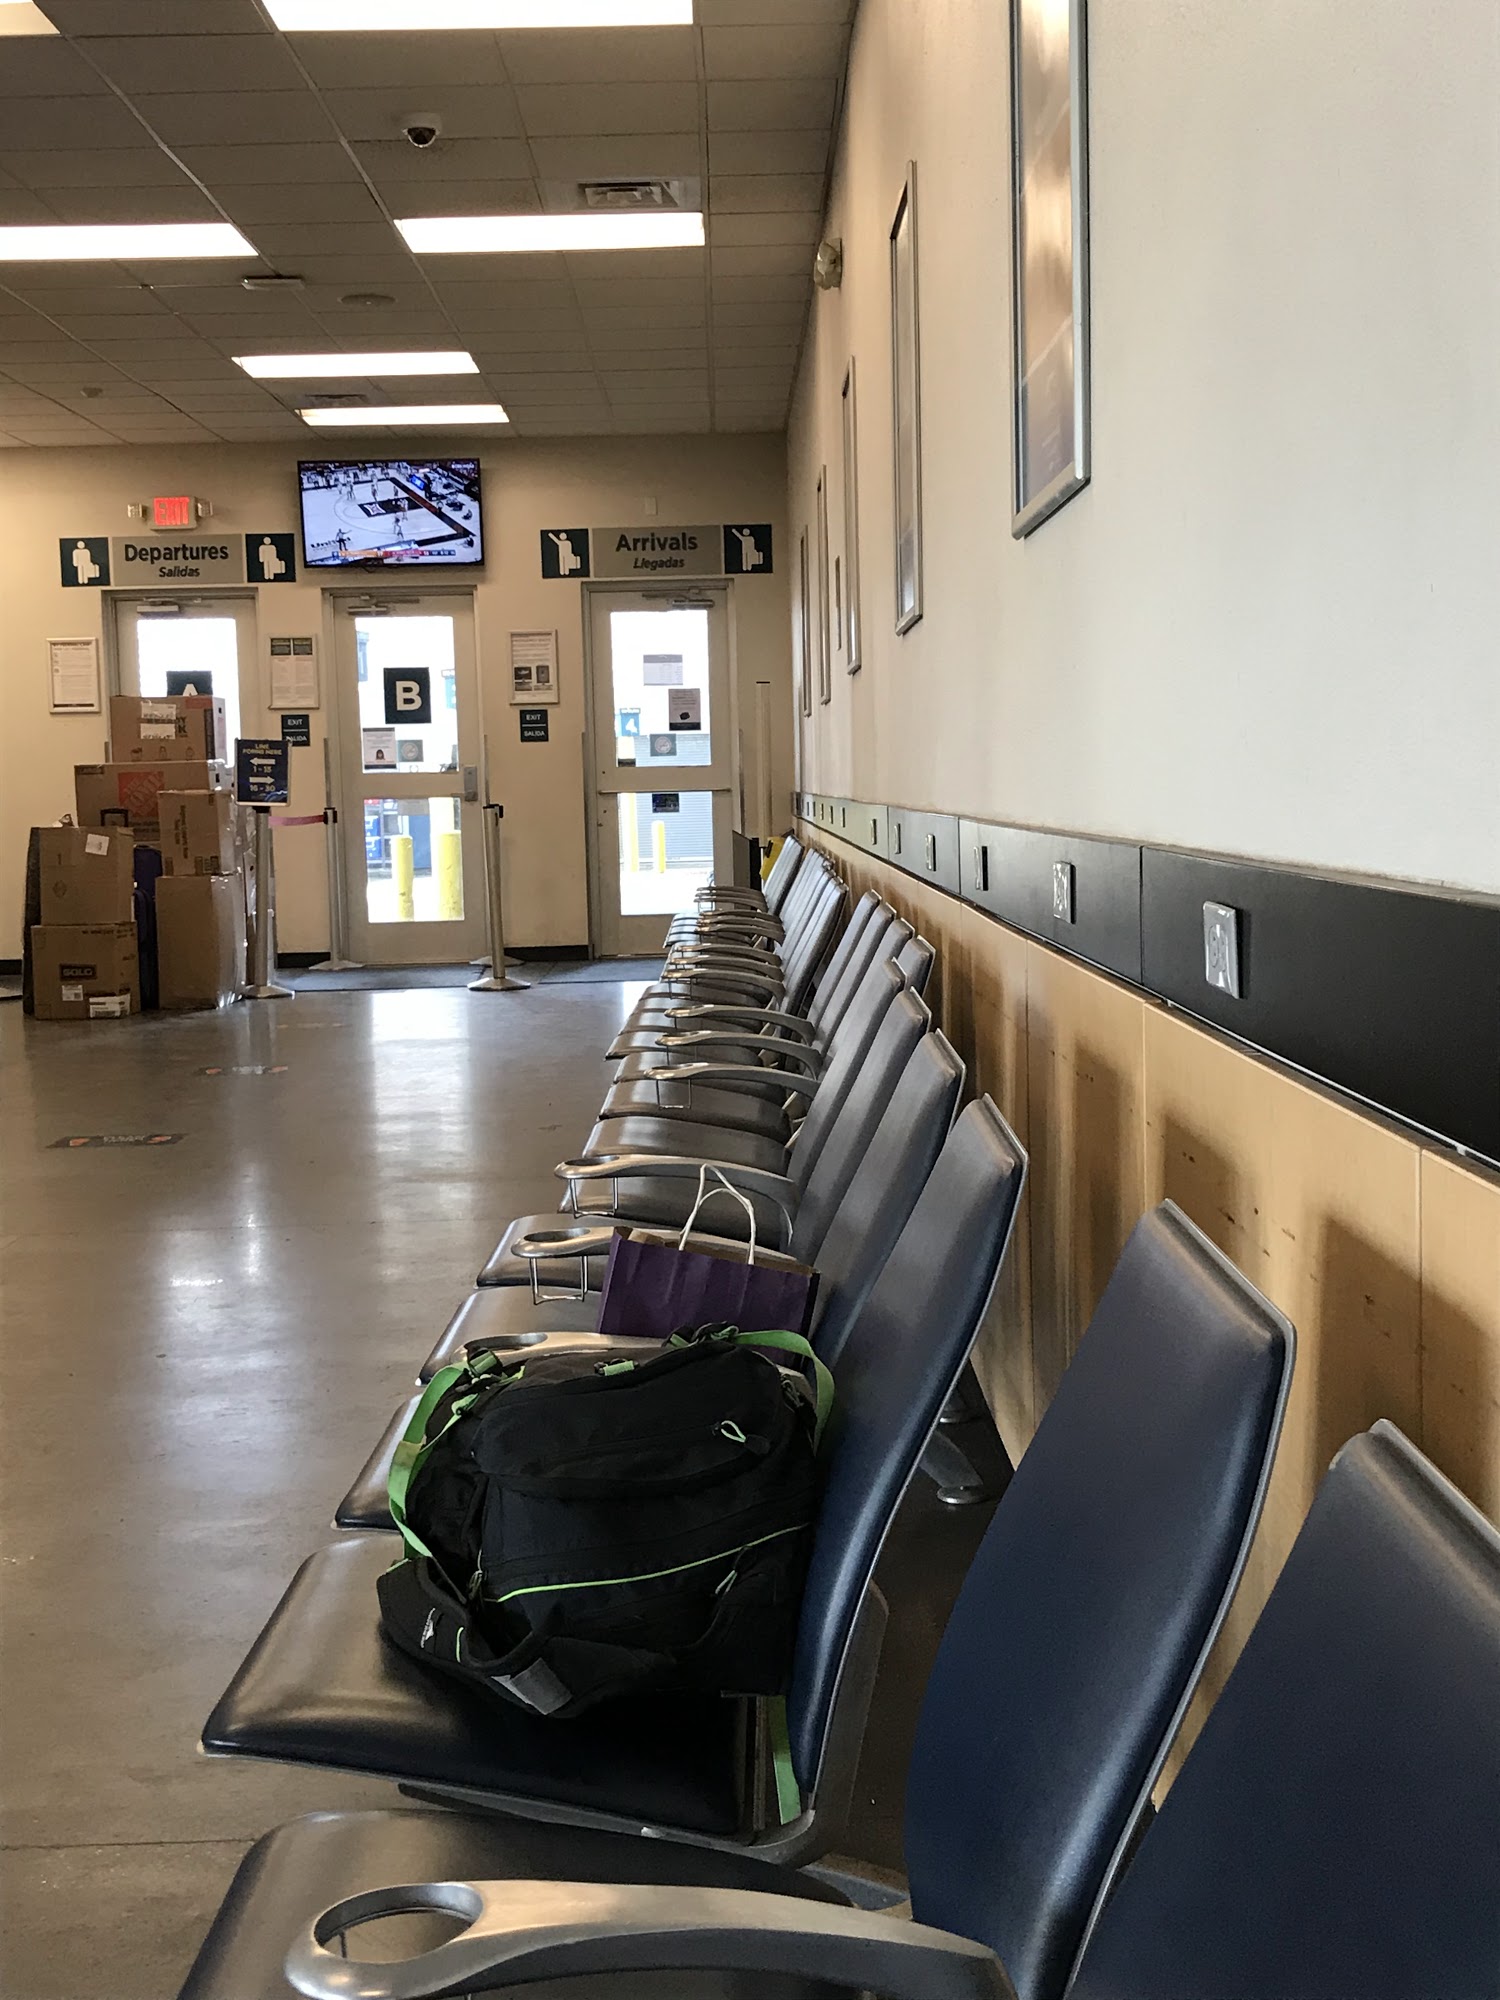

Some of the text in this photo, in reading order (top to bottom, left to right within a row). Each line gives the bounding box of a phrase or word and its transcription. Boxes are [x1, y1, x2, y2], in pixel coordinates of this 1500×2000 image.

[153, 496, 190, 526] EXIT
[615, 532, 699, 552] Arrivals
[124, 543, 229, 564] Departures
[158, 566, 201, 578] Salidas
[632, 557, 686, 571] Llegadas
[395, 680, 423, 711] B
[525, 713, 541, 721] EXIT
